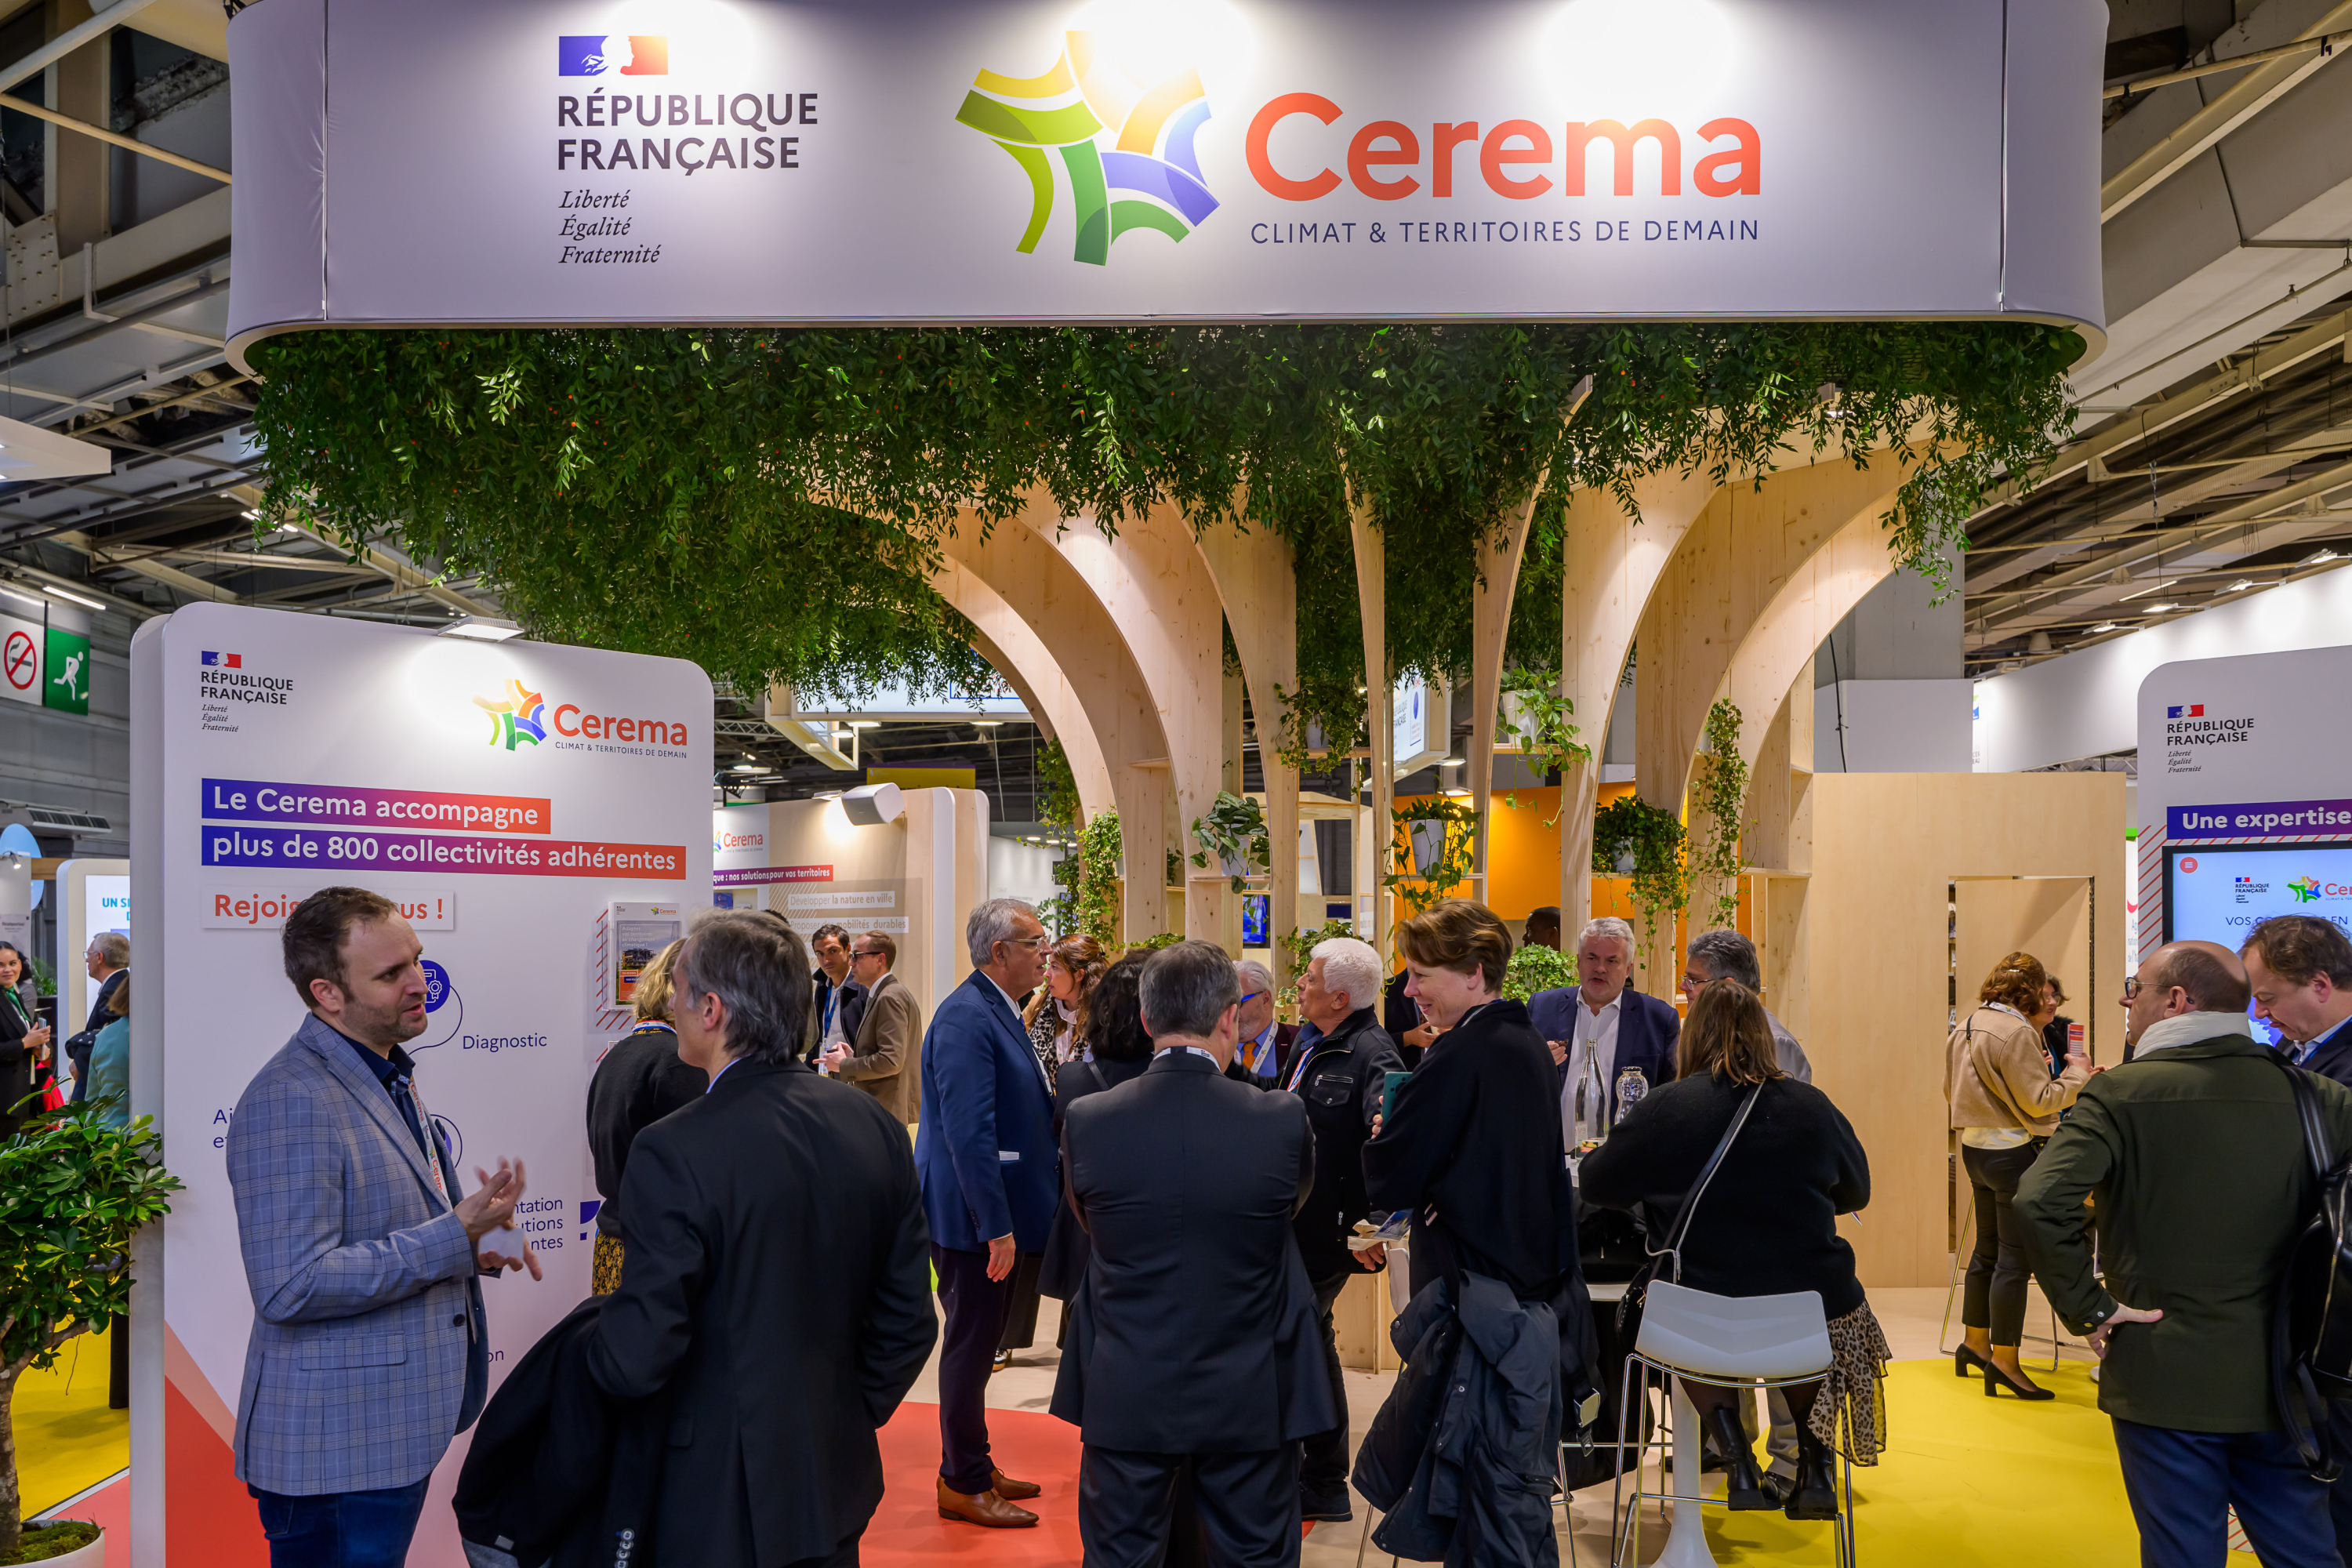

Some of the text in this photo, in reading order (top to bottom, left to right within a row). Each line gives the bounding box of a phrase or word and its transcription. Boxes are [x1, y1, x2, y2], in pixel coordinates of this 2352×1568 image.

[557, 87, 818, 132] RÉPUBLIQUE
[1245, 92, 1761, 201] Cerema
[557, 136, 800, 176] FRANÇAISE
[558, 189, 630, 209] Liberté
[558, 214, 632, 241] Égalité
[1250, 220, 1759, 244] CLIMAT & TERRITOIRES DE DEMAIN
[558, 244, 662, 265] Fraternité
[201, 670, 294, 691] RÉPUBLIQUE
[201, 686, 287, 705] FRANÇAISE
[201, 704, 228, 713] Liberté
[201, 712, 229, 723] Égalité
[554, 703, 688, 746] Cerema
[2166, 717, 2255, 734] RÉPUBLIQUE
[201, 723, 239, 732] Fraternité
[2166, 731, 2249, 746] FRANÇAISE
[555, 742, 585, 751] CLIMAT
[595, 745, 643, 755] TERRITOIRES
[658, 750, 687, 759] DEMAIN
[2167, 757, 2192, 766] Égalité
[2167, 765, 2202, 774] Fraternité
[213, 786, 539, 829] Le Cerema accompagne
[2182, 806, 2352, 832] Une expertise
[723, 833, 764, 848] Cerema
[212, 831, 676, 871] plus de 800 collectivités adhérentes
[713, 874, 724, 884] que
[741, 870, 770, 880] solutions
[769, 871, 784, 881] pour
[797, 867, 830, 877] territoires
[2325, 883, 2352, 896] Cer
[102, 898, 118, 908] UN
[399, 902, 428, 920] us
[437, 898, 444, 920] !
[790, 895, 830, 908] Développer
[832, 895, 838, 904] la
[840, 895, 864, 904] nature
[877, 893, 892, 903] ville
[790, 920, 821, 931] Proposer
[836, 919, 869, 929] mobilités
[873, 918, 906, 929] durables
[2225, 916, 2252, 926] VOS
[462, 1031, 547, 1053] Diagnostic
[410, 1083, 424, 1122] Cerema
[212, 1136, 228, 1149] e
[514, 1197, 563, 1214] ntation
[531, 1238, 564, 1250] ntes
